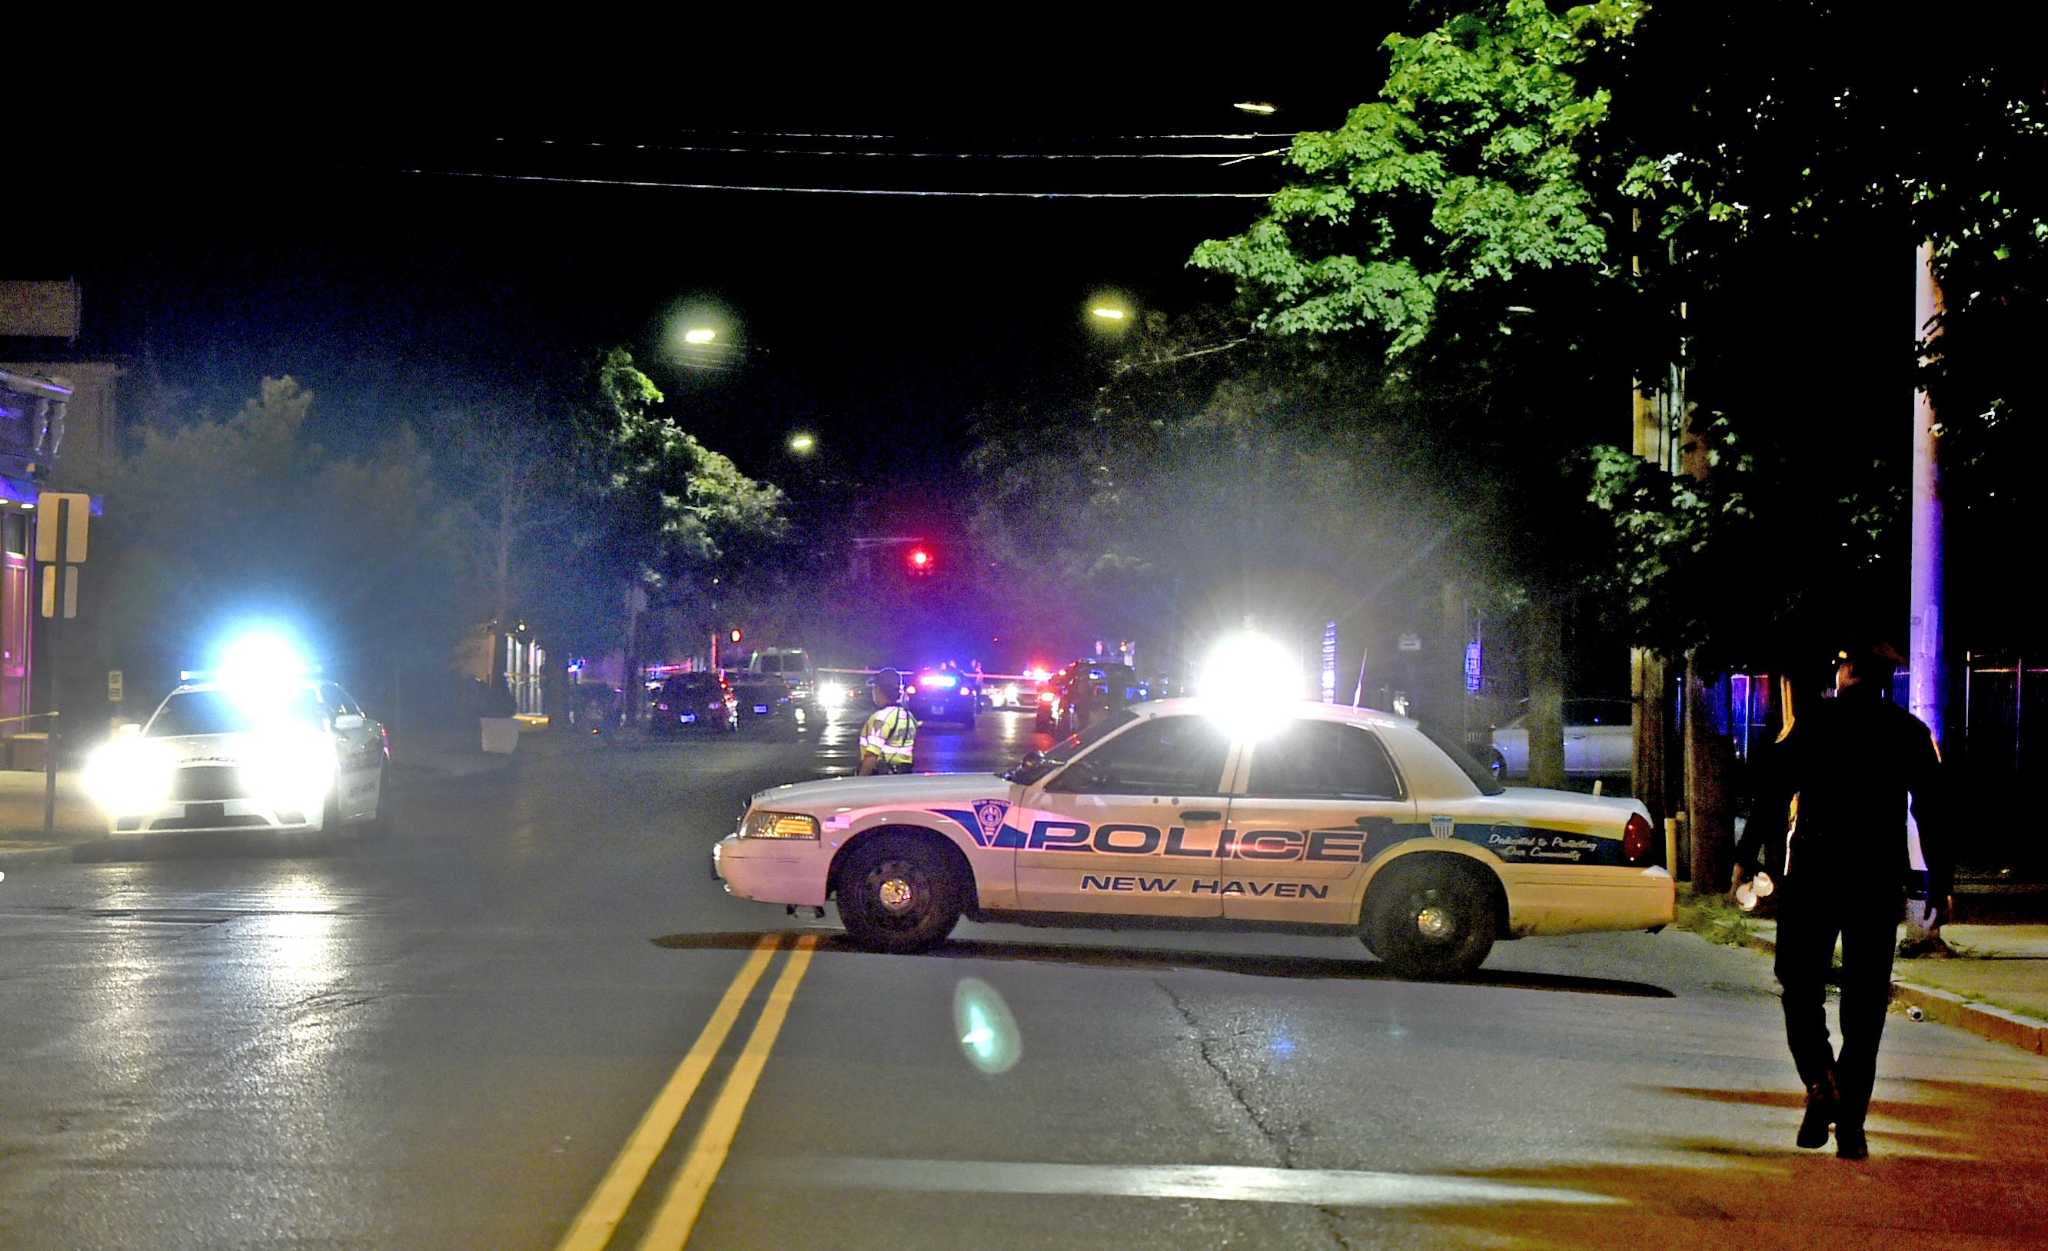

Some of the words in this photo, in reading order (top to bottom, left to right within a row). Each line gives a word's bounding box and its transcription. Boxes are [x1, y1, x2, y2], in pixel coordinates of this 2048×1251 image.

[1028, 820, 1367, 863] POLICE
[1080, 874, 1176, 893] NEW
[1190, 879, 1329, 900] HAVEN
